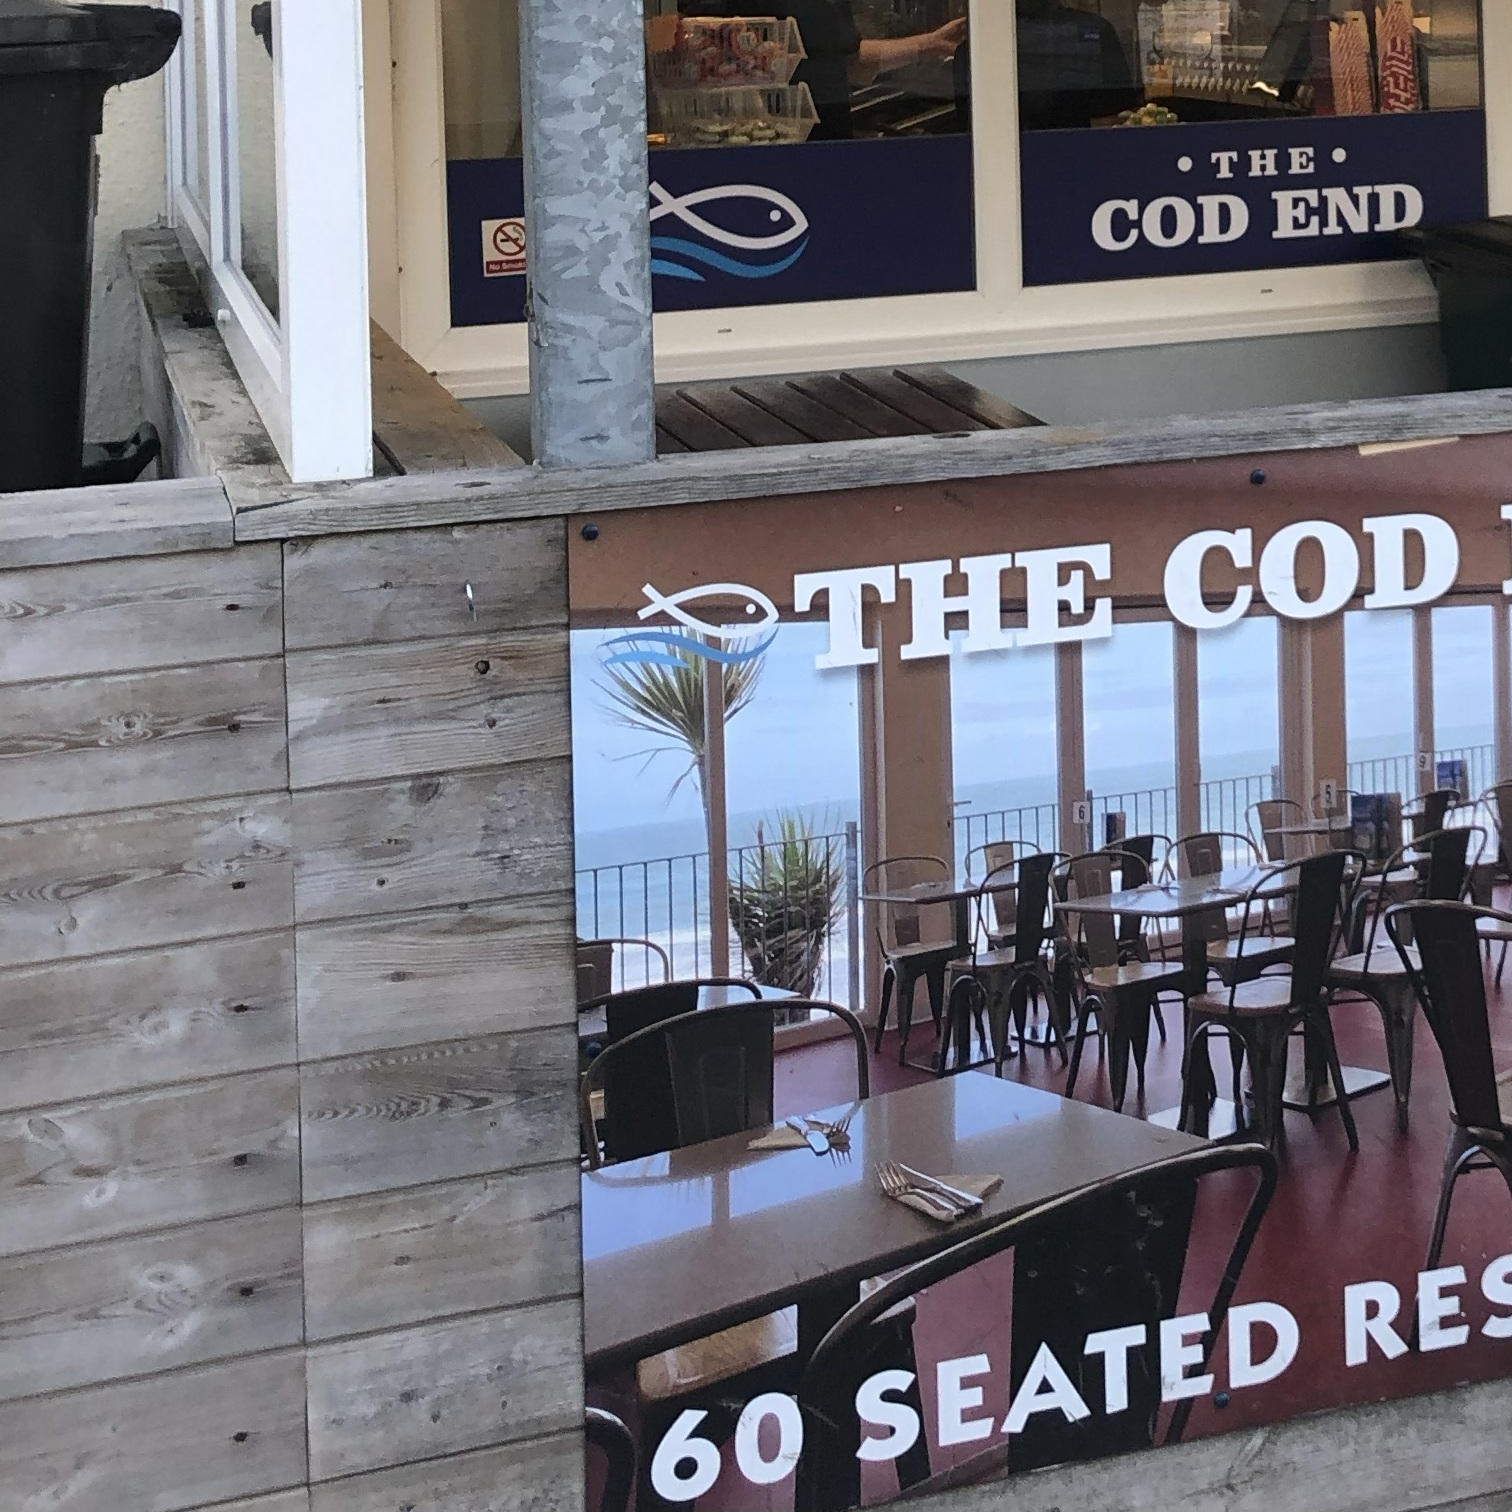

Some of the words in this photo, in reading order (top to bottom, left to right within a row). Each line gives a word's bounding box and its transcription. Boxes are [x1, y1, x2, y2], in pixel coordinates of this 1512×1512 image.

[1090, 194, 1250, 253] COD
[1270, 182, 1425, 240] END
[1210, 146, 1316, 180] THE
[793, 542, 1114, 670] THE
[1163, 512, 1460, 630] COD
[650, 1391, 805, 1503] 60
[855, 1300, 1300, 1462] SEATED
